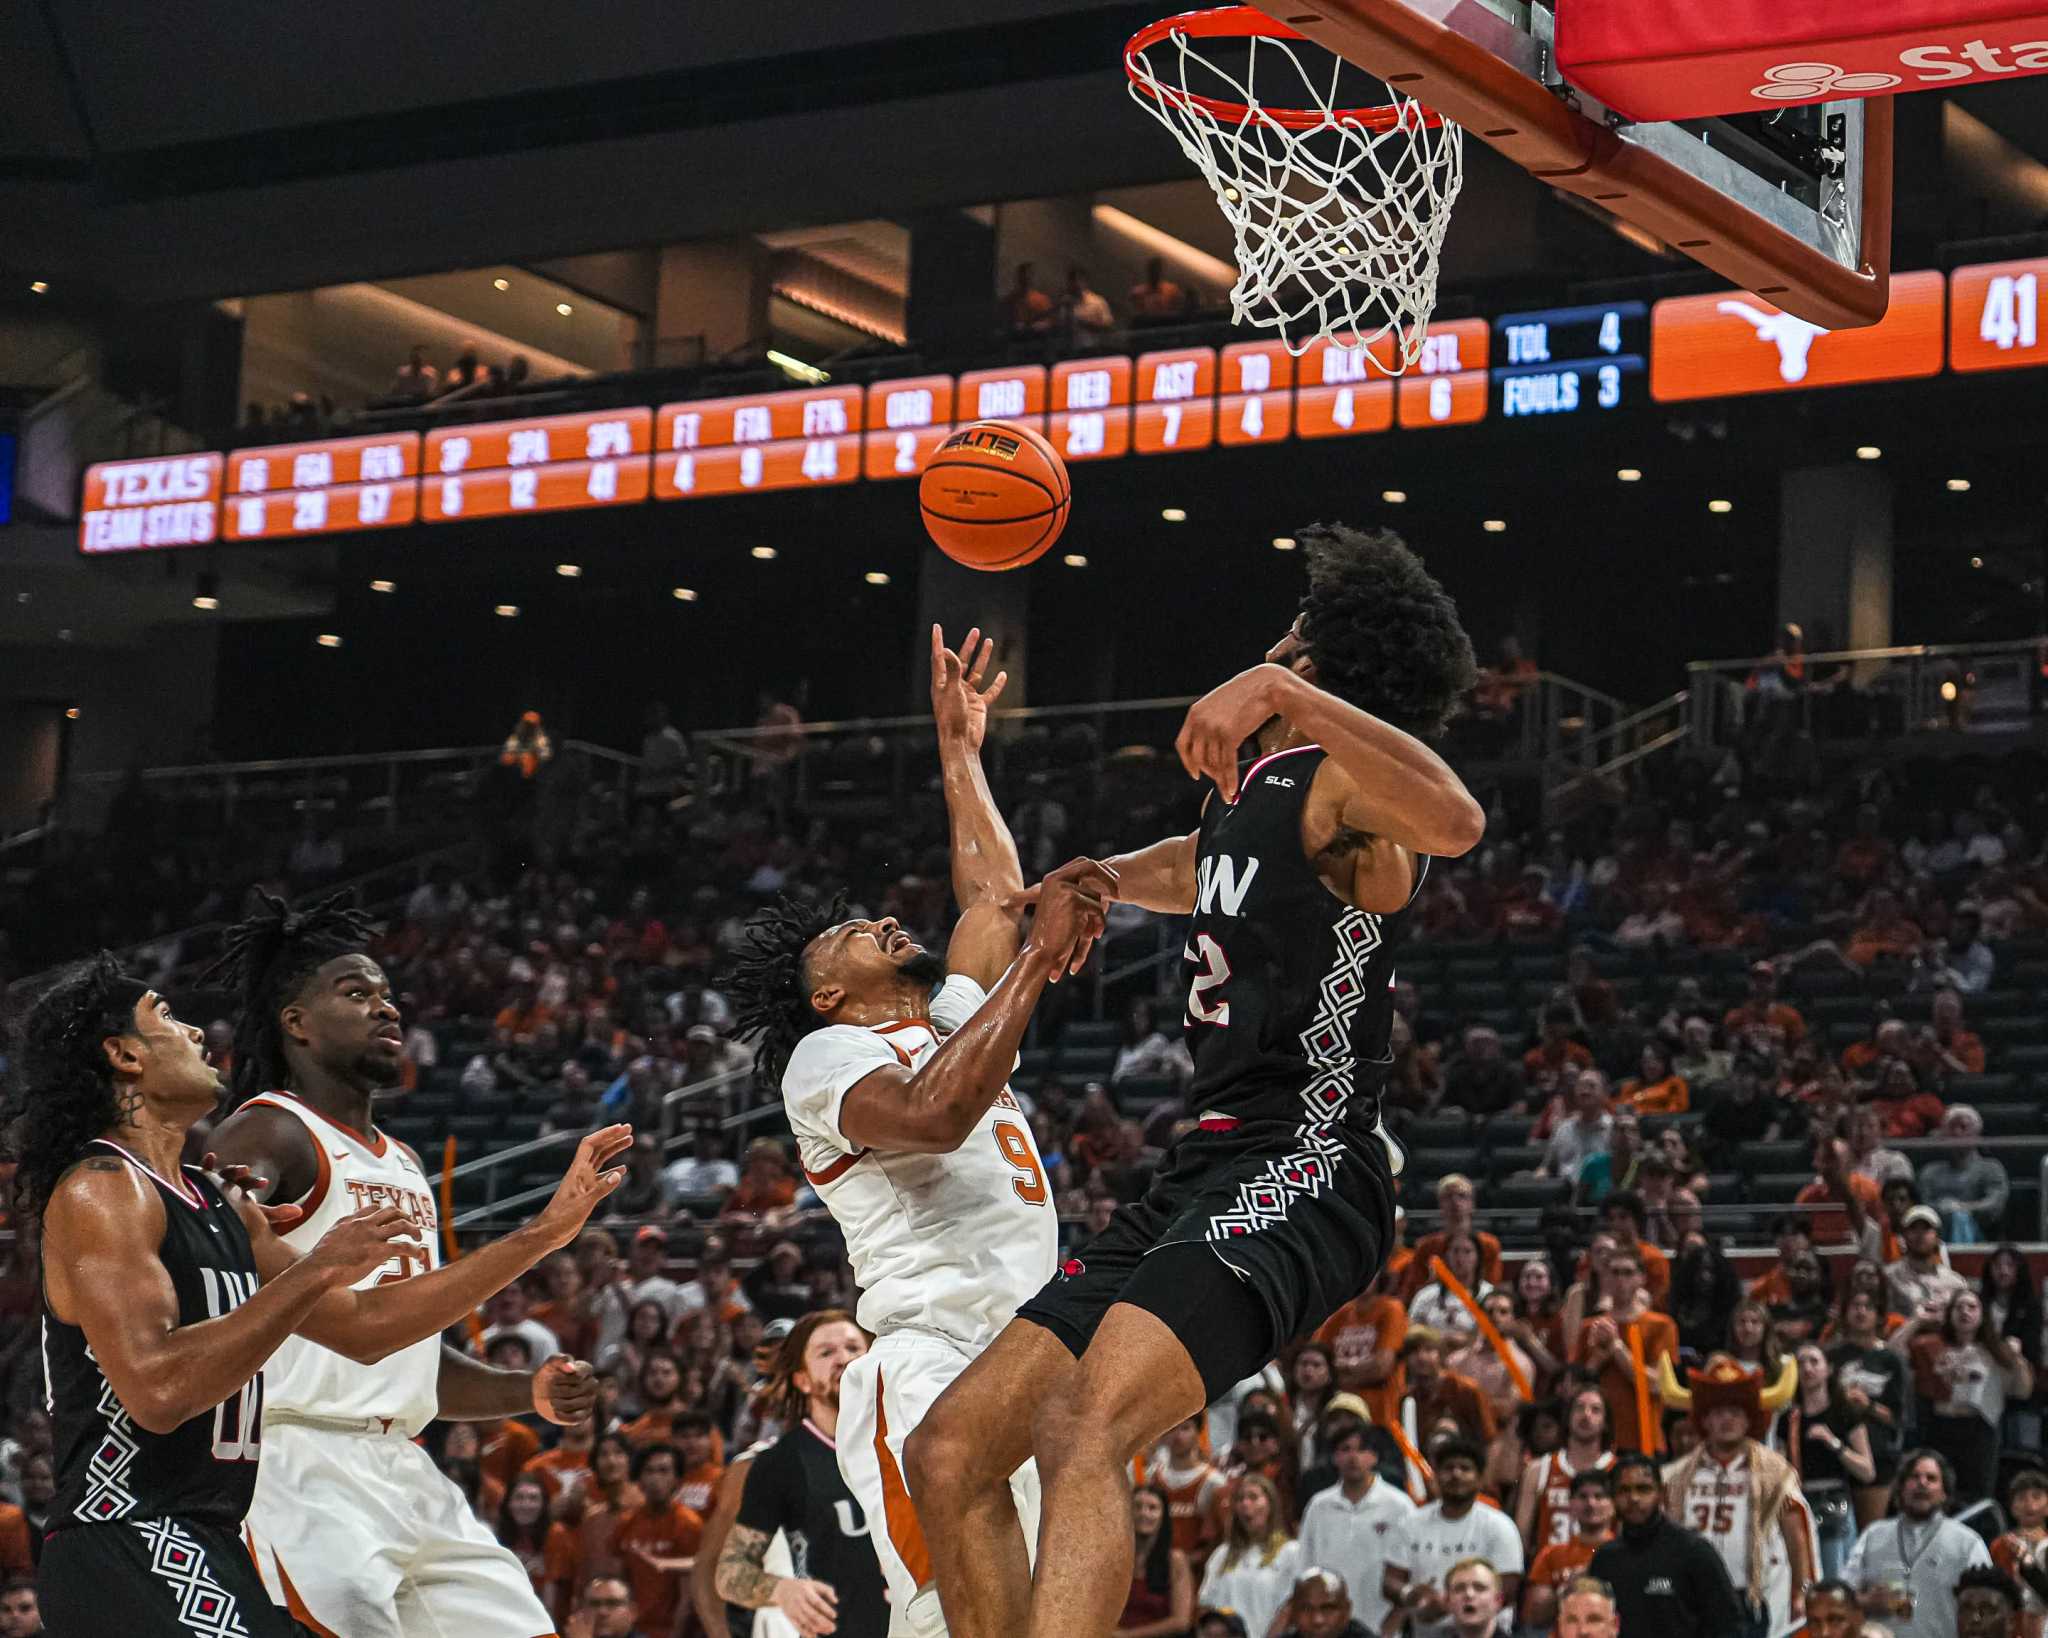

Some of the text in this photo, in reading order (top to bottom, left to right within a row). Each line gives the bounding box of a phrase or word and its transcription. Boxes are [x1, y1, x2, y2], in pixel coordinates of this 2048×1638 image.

[1899, 40, 2048, 81] Sta
[1982, 274, 2036, 347] 41
[1506, 312, 1620, 362] TOL 4
[1154, 361, 1196, 398] AST
[1430, 378, 1451, 418] 6
[1504, 365, 1619, 416] FOULS 3
[1162, 405, 1181, 443] 7
[1242, 397, 1262, 435] 4
[1333, 388, 1353, 426] 4
[674, 414, 699, 447] FT
[944, 431, 1022, 456] ELITE
[674, 455, 693, 490] 4
[803, 440, 836, 477] 44
[896, 432, 916, 470] 2
[102, 457, 210, 506] TEXAS
[83, 500, 216, 552] TEAM STATS
[1264, 774, 1296, 788] SLC
[992, 1119, 1048, 1207] 9
